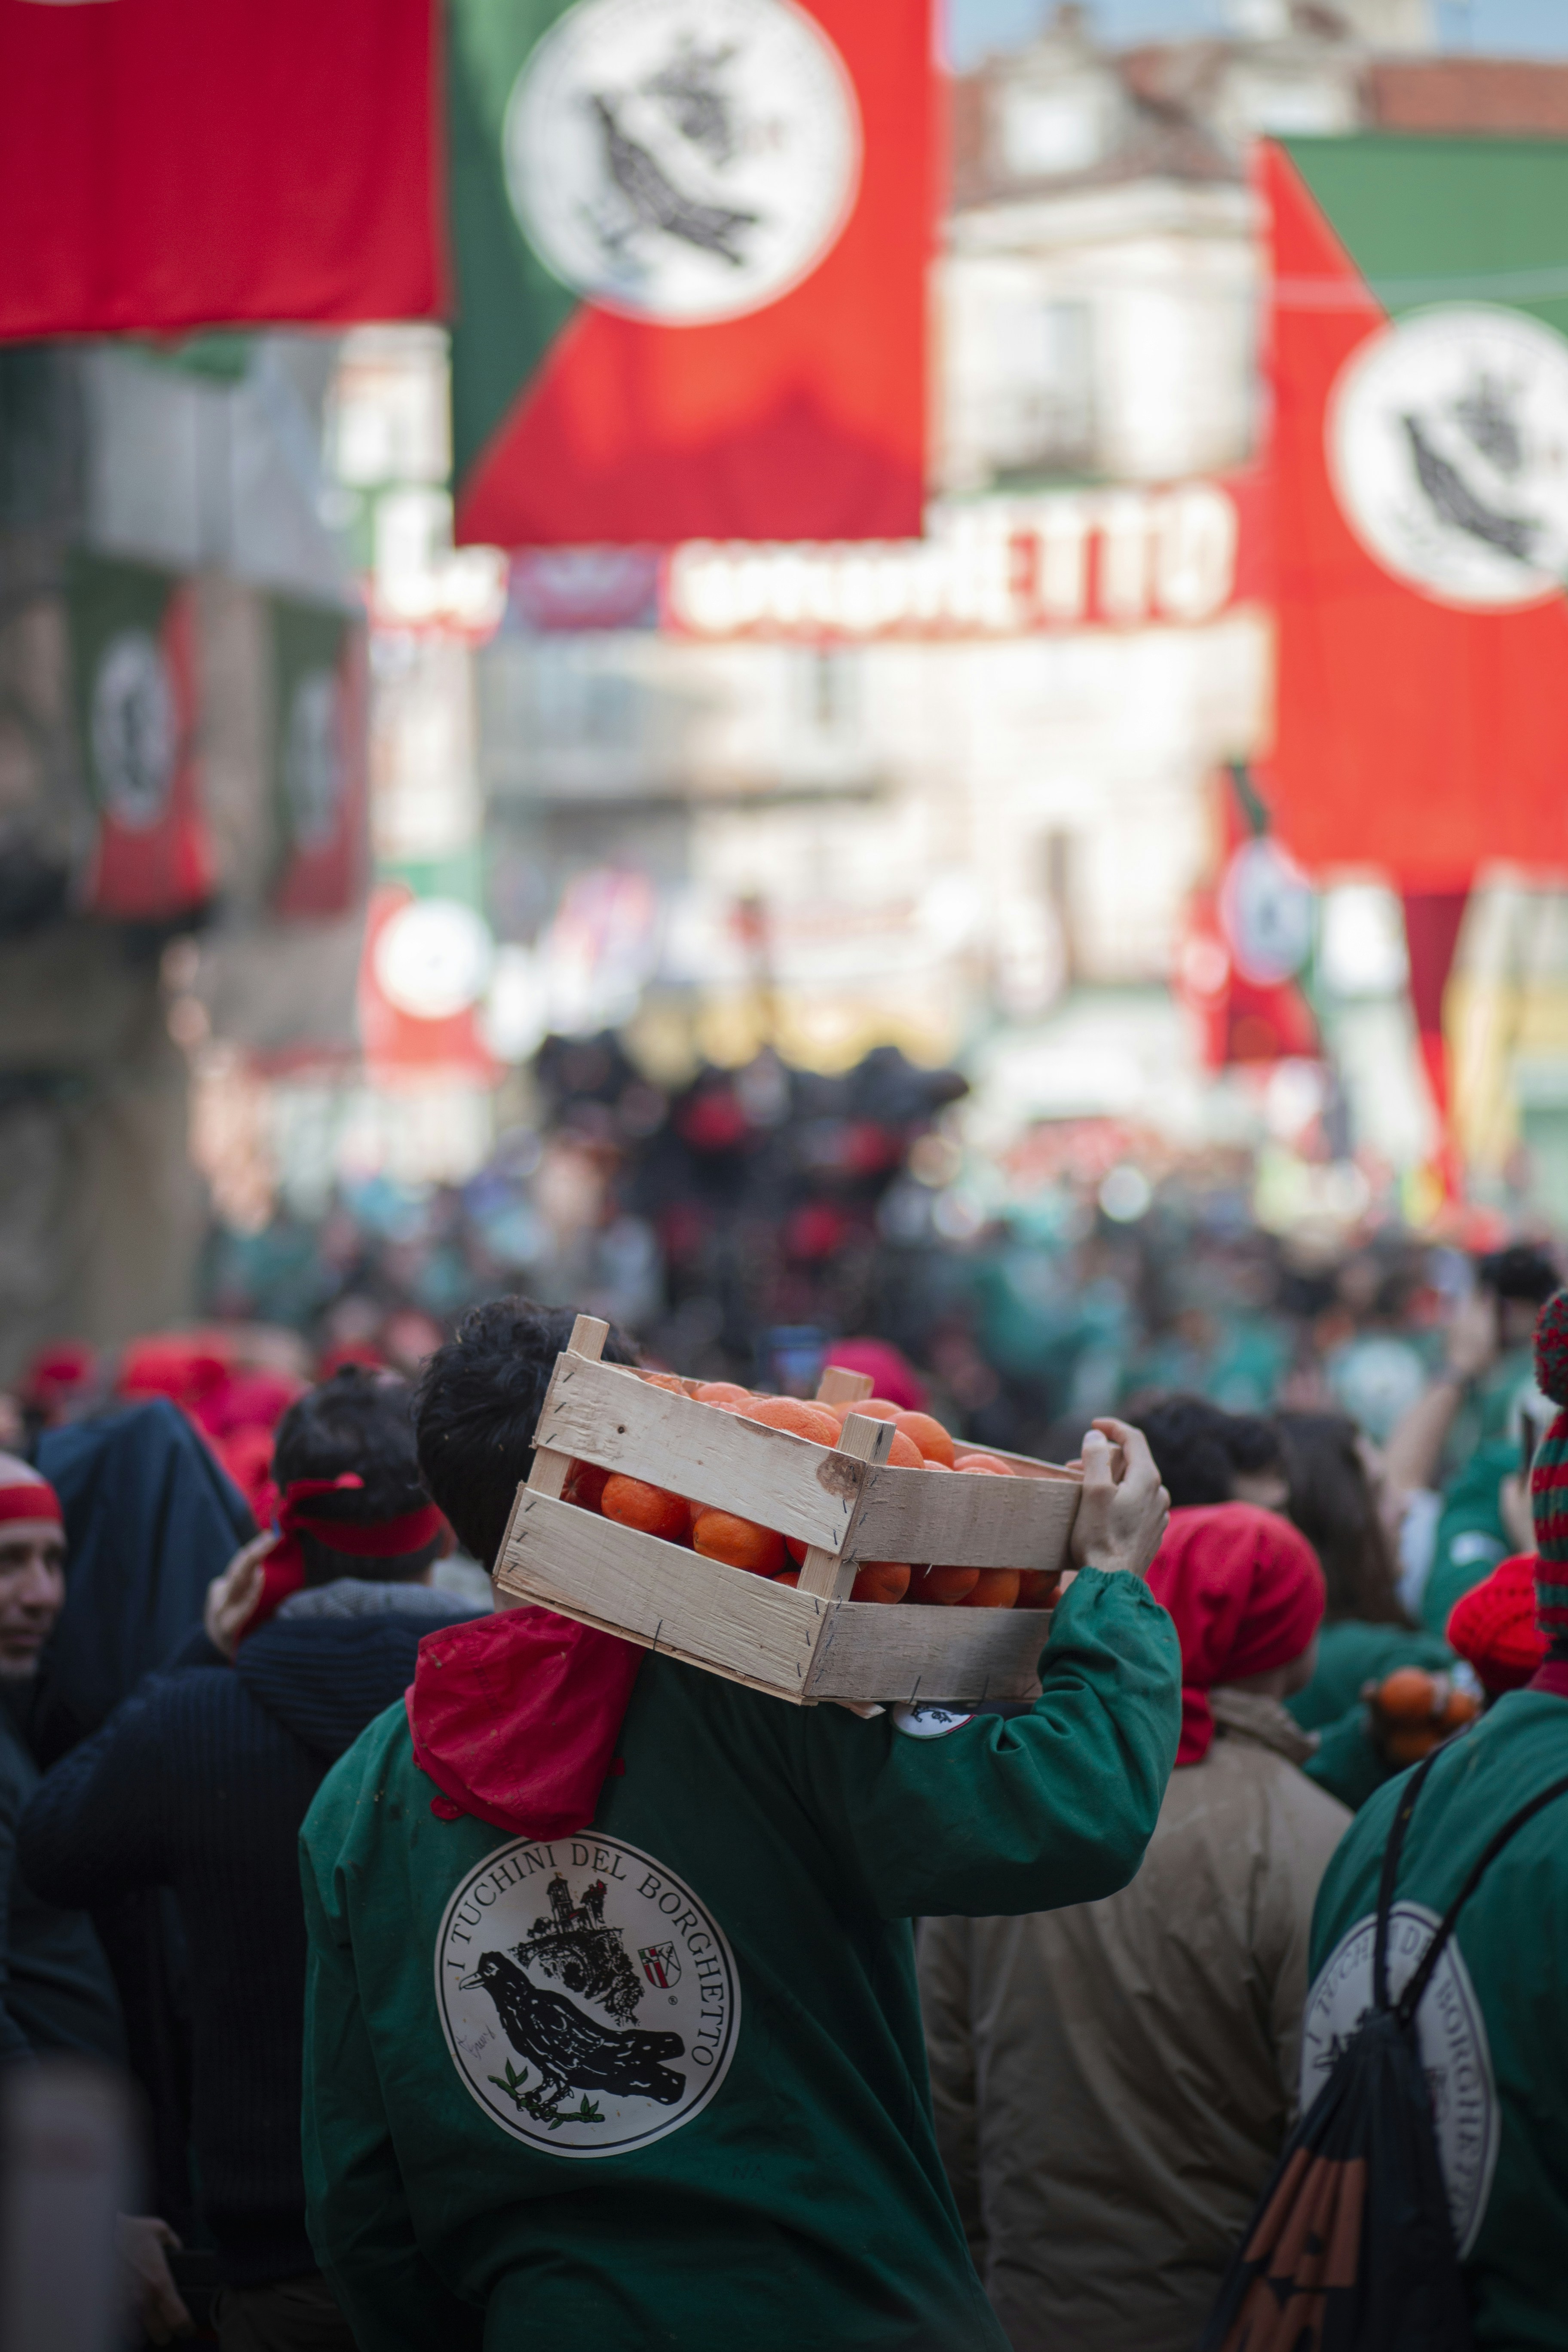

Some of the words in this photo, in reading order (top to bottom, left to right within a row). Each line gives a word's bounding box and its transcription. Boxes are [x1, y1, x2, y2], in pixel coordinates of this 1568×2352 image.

[451, 1845, 557, 1944] TUCHINI
[571, 1843, 627, 1880] DEL
[447, 1960, 465, 1971] I
[637, 1873, 725, 2066] BORGHETTO
